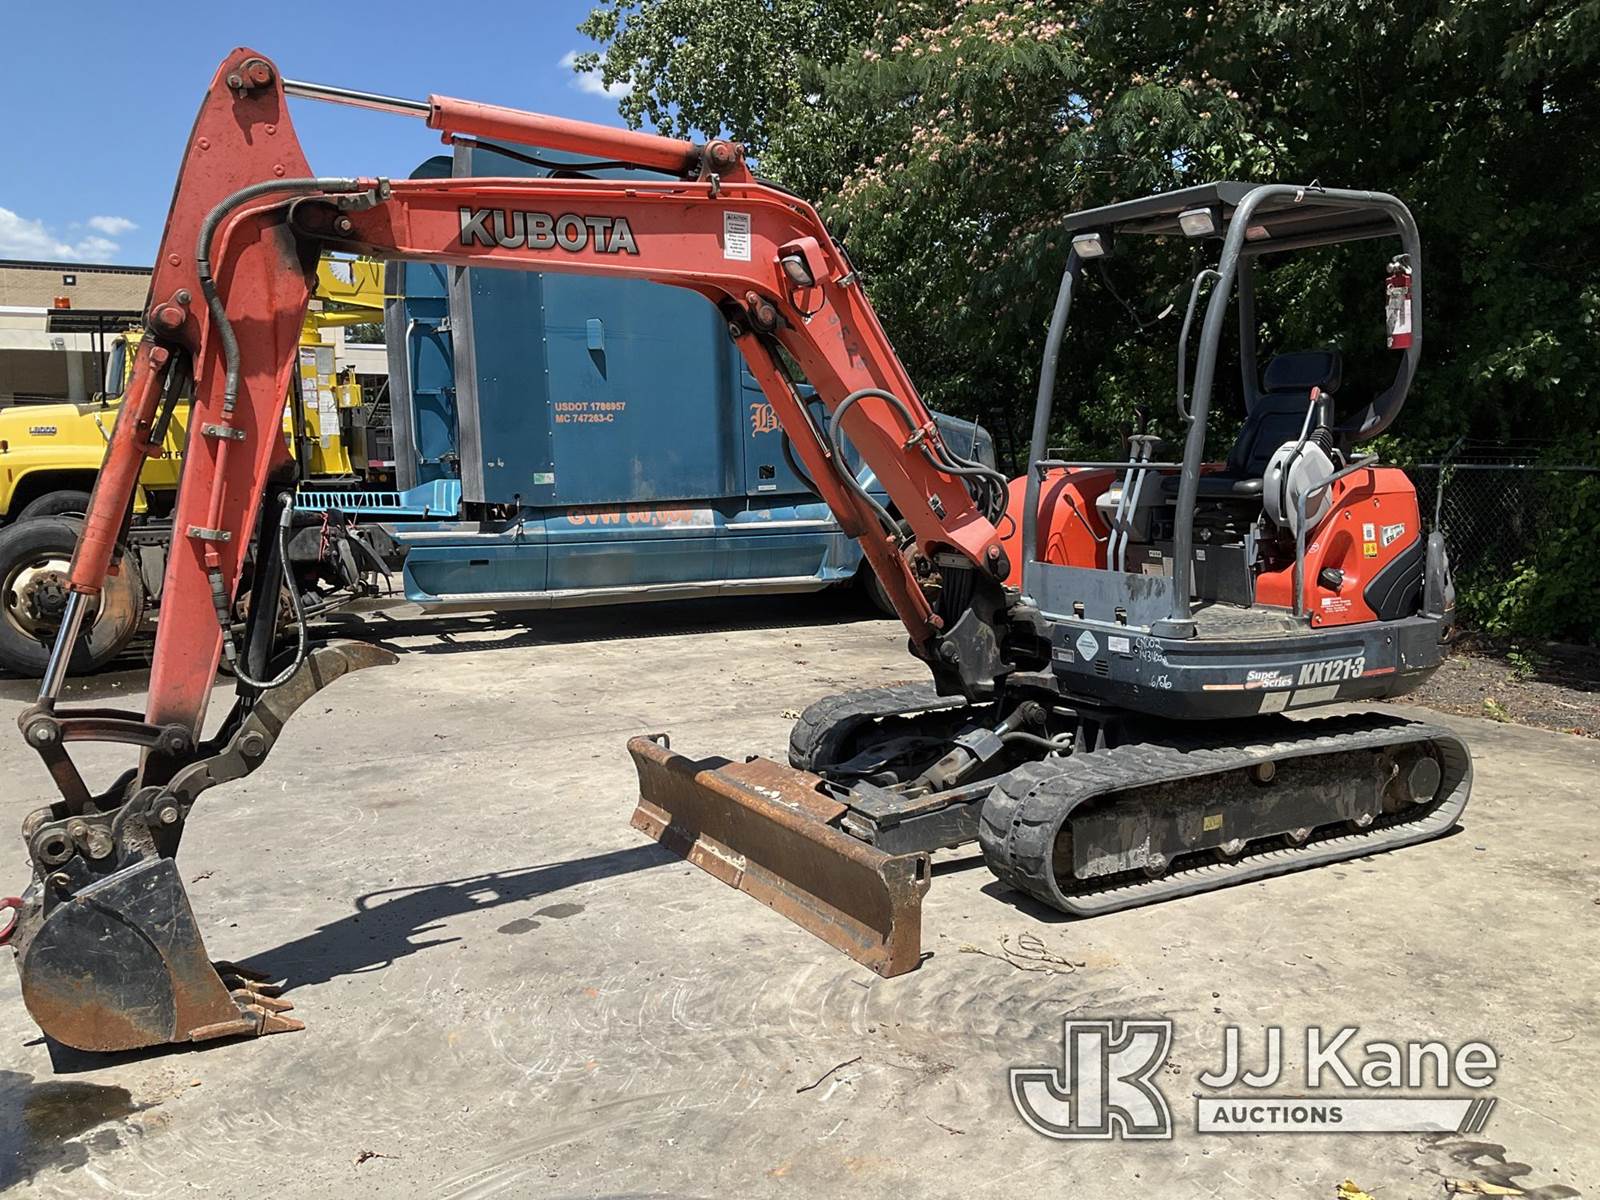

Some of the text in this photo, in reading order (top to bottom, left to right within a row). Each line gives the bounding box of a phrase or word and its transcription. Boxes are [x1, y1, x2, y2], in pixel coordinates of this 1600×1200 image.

[459, 207, 638, 254] KUBOTA
[554, 402, 588, 411] USDOT
[555, 414, 571, 423] MC
[567, 505, 620, 525] GVW
[1246, 670, 1280, 680] Super
[1298, 657, 1365, 685] KX121-3
[1262, 677, 1293, 688] Series
